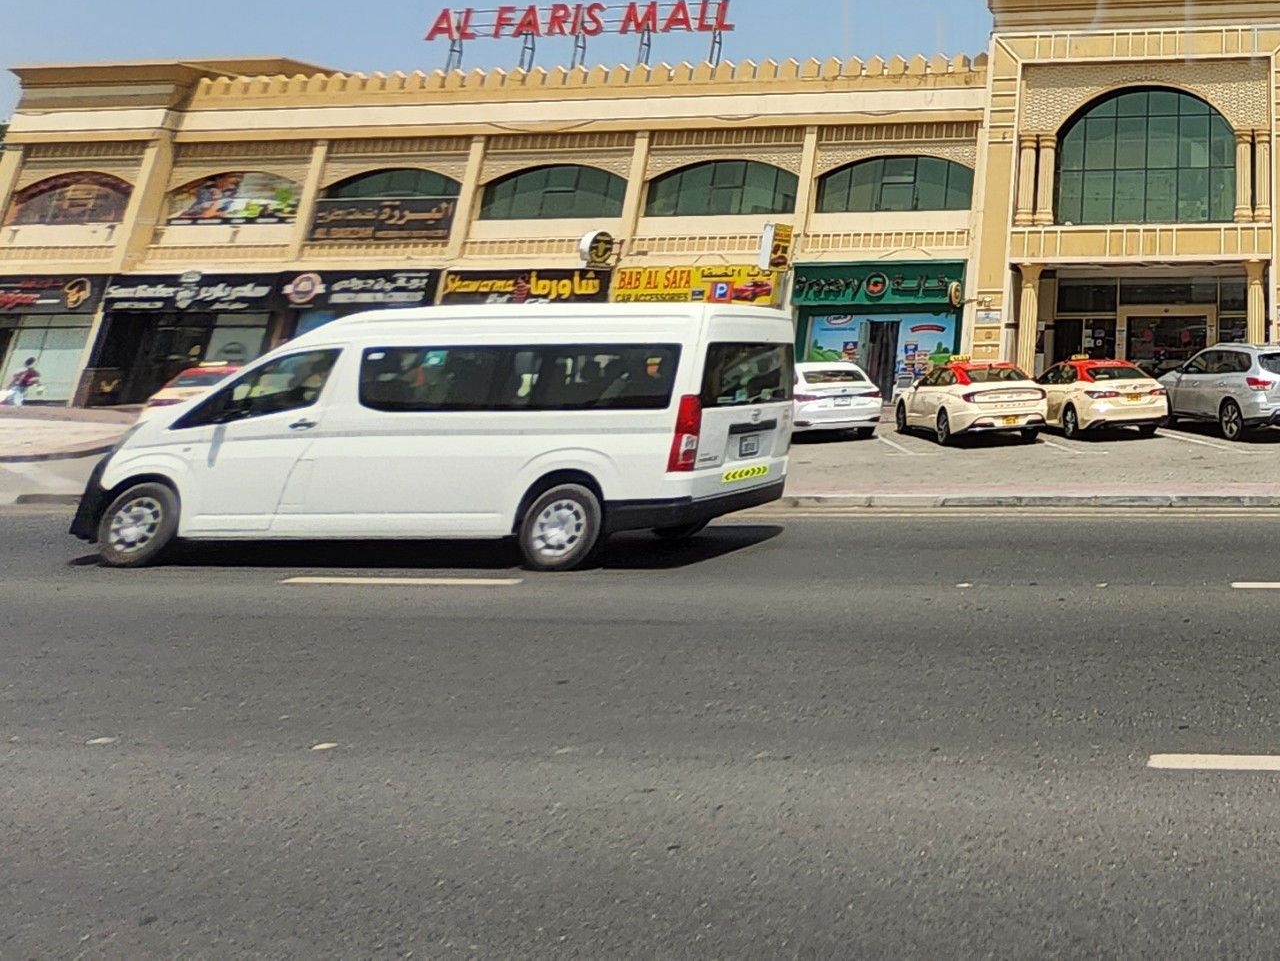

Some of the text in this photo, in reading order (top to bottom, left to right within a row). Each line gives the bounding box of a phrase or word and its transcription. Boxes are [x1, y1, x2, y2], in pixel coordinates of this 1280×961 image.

[424, 7, 477, 41] AL
[492, 2, 608, 39] FARIS
[447, 274, 516, 294] Shawarma
[530, 271, 600, 300] شاورما
[619, 269, 692, 289] BAB AL SAFA
[715, 282, 729, 299] P
